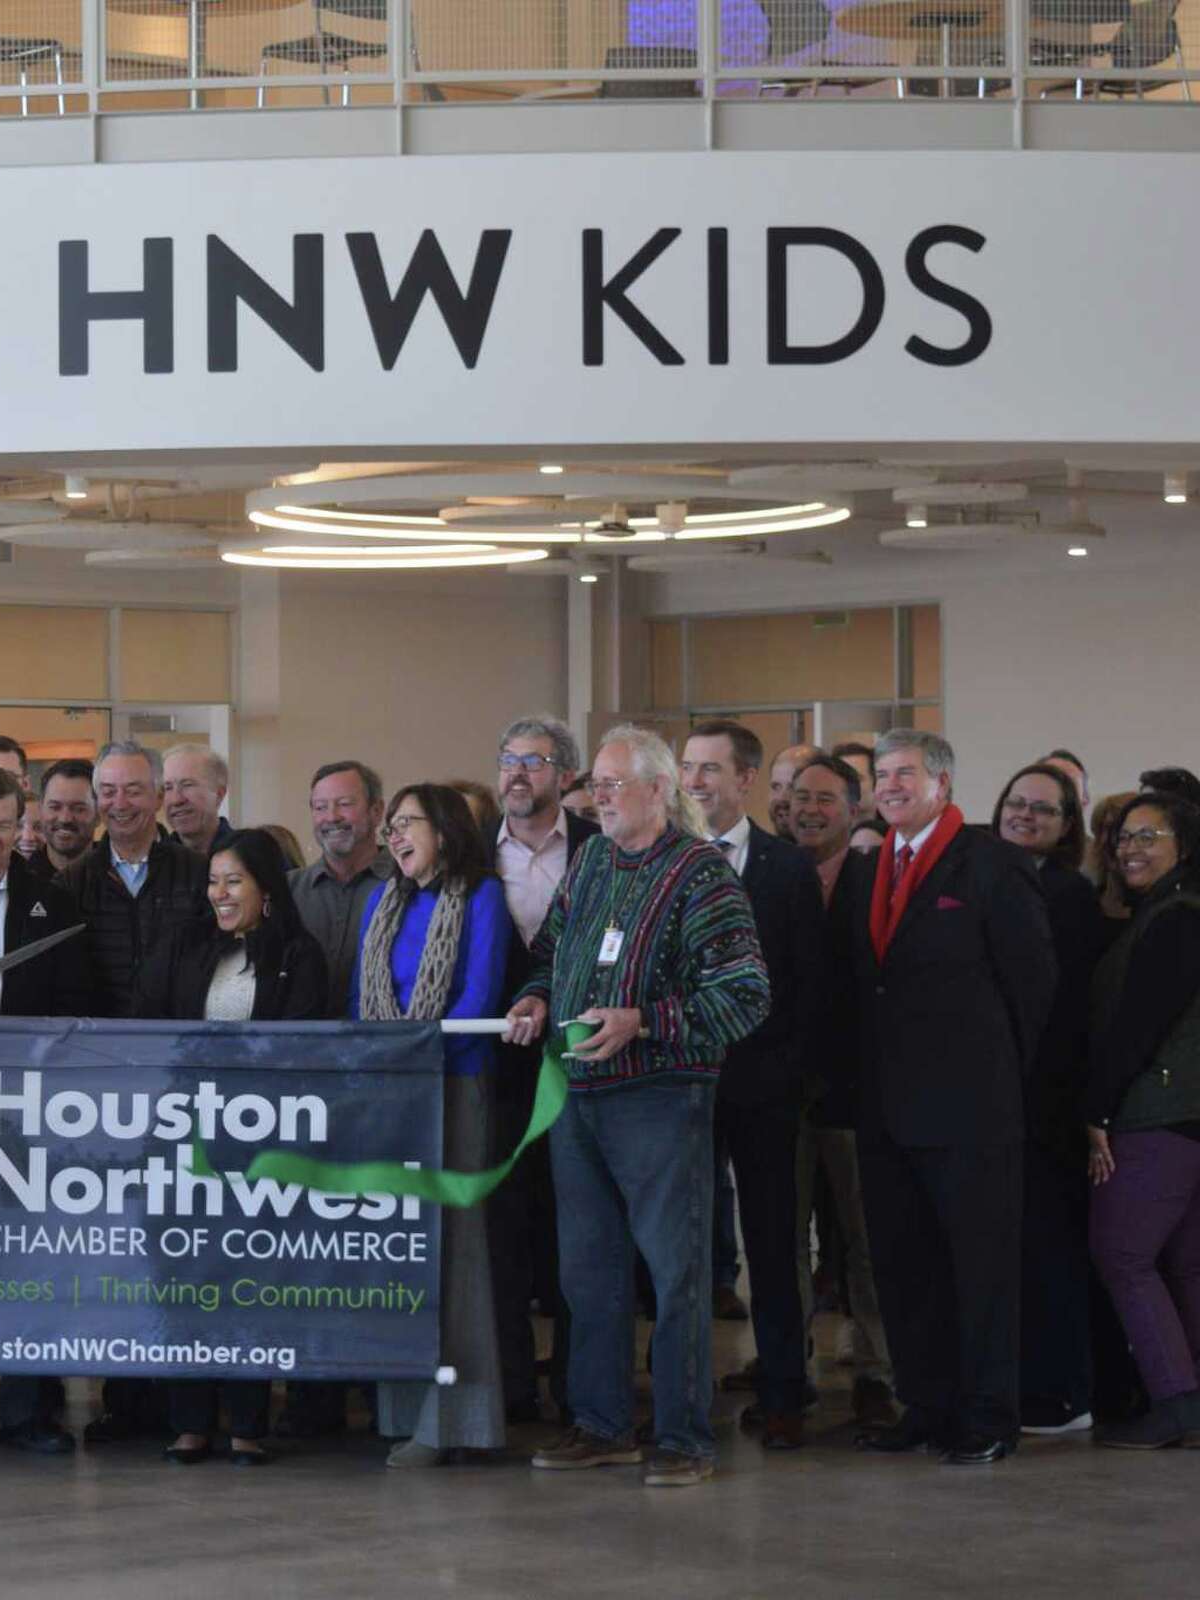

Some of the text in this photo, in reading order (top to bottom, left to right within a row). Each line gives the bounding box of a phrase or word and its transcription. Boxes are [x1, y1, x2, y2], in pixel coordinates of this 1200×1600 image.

[58, 224, 993, 375] HNW KIDS
[158, 1227, 209, 1257] OF
[221, 1228, 428, 1262] COMMERCE
[100, 1276, 220, 1312] Thriving
[231, 1278, 426, 1315] Community
